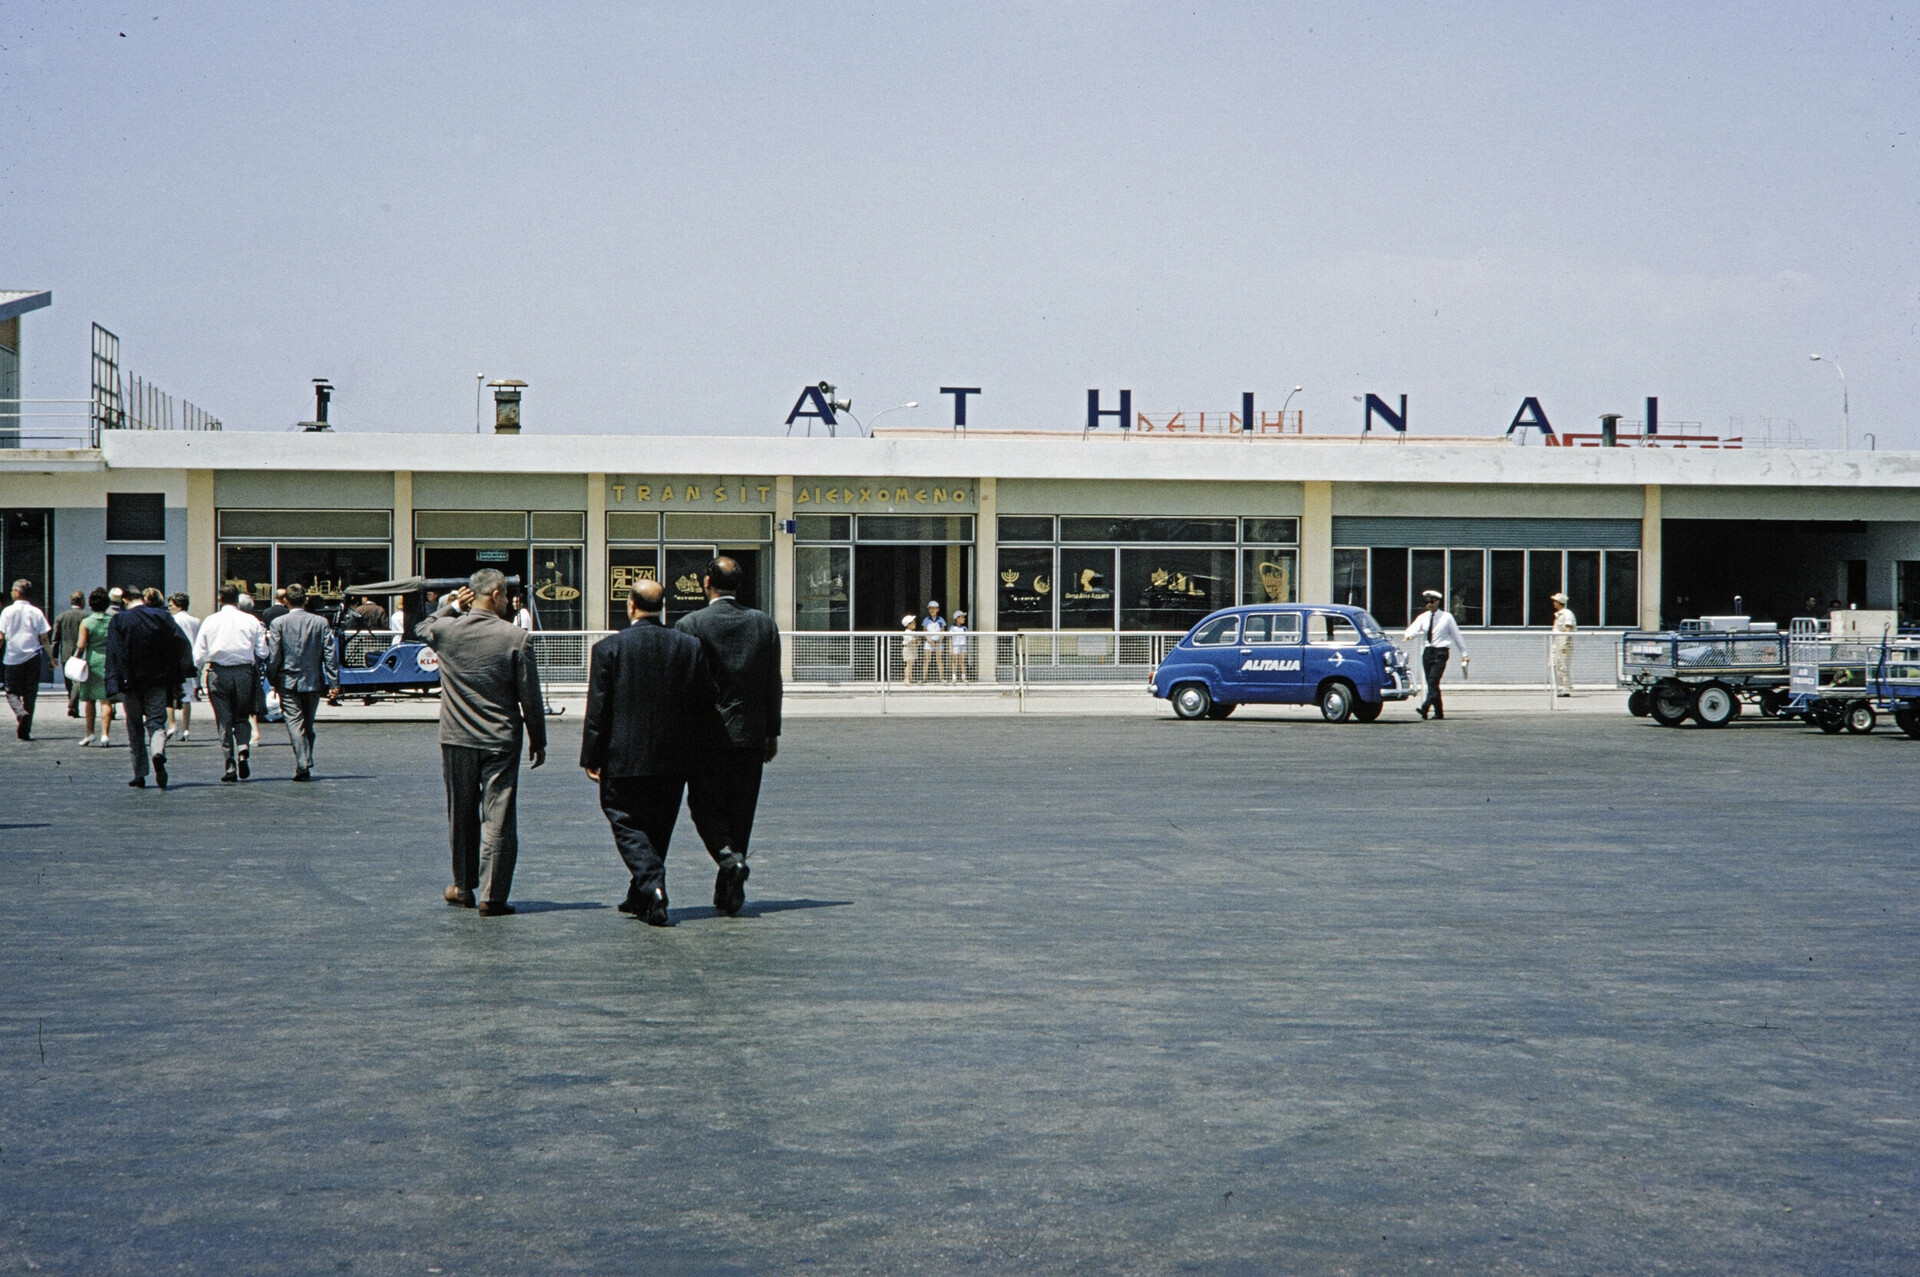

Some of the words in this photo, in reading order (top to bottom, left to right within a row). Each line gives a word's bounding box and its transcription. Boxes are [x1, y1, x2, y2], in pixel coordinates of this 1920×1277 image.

[785, 386, 1659, 435] ATHINAI
[612, 485, 770, 503] TRANSIT
[1241, 660, 1301, 671] ALITALIA
